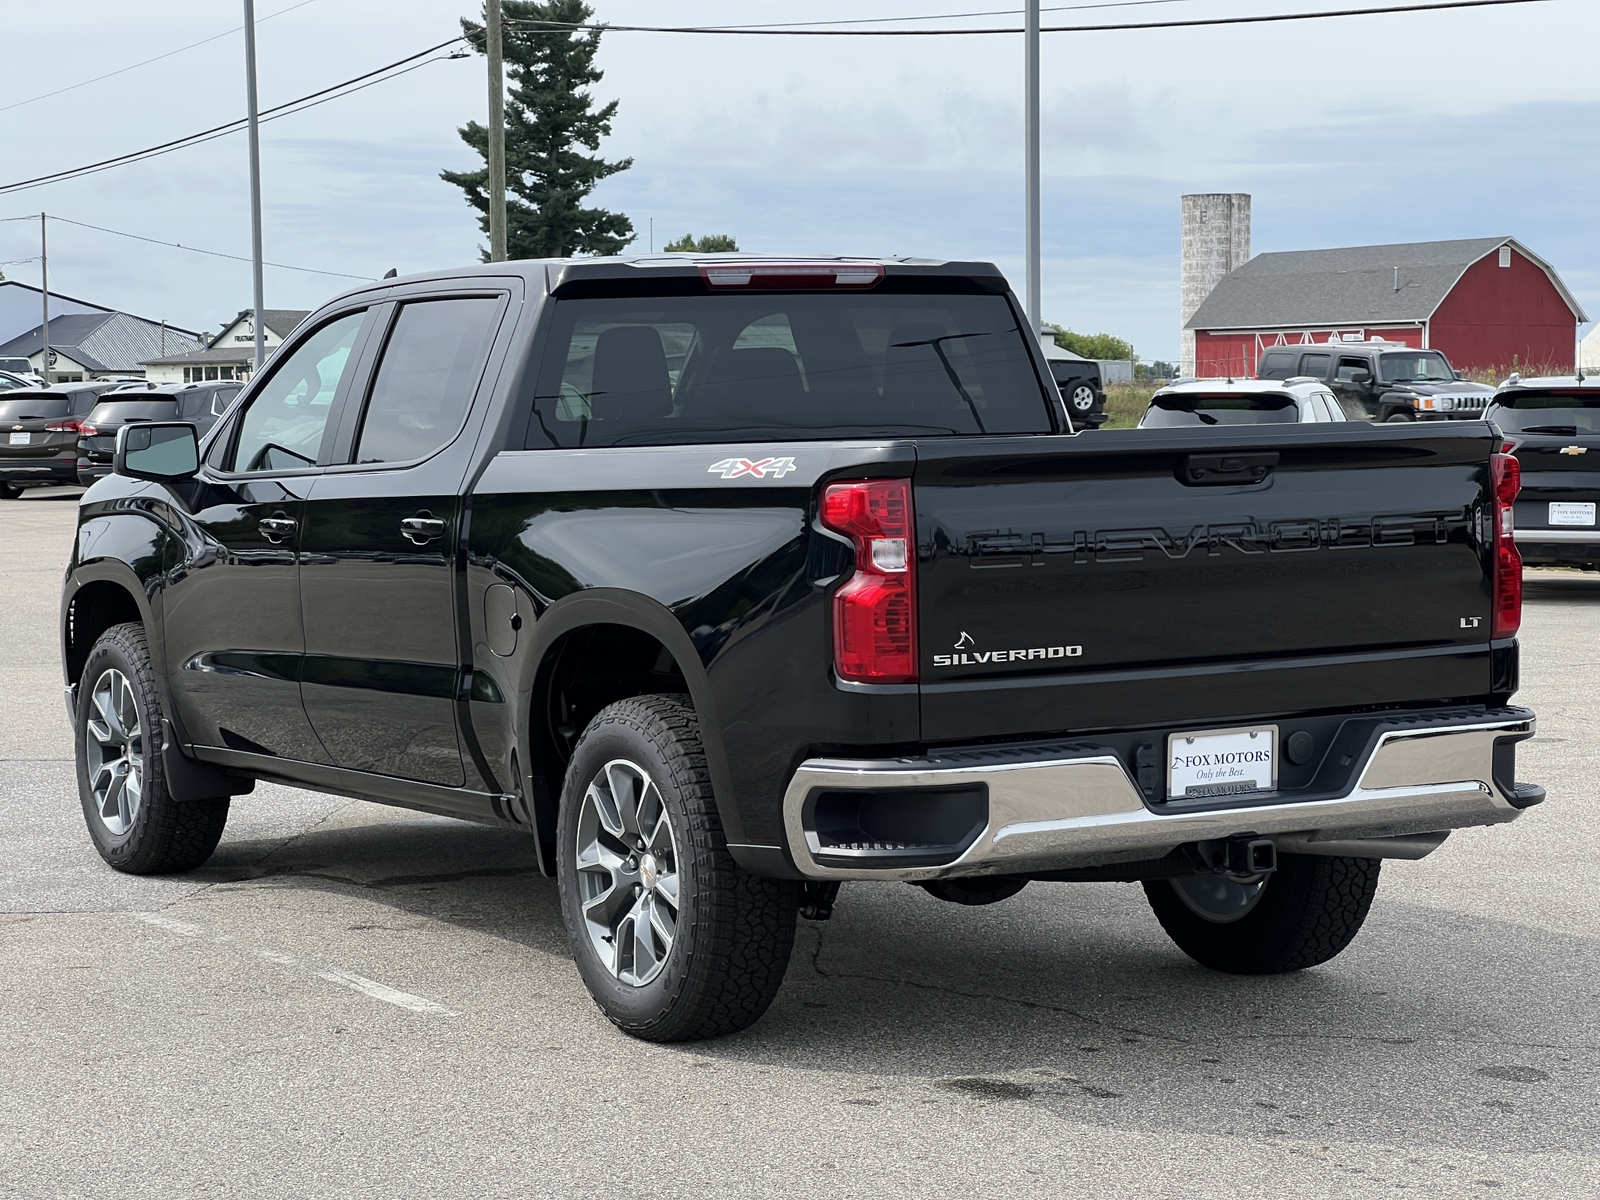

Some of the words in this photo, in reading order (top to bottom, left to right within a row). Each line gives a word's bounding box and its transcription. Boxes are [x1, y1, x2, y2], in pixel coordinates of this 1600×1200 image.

[968, 512, 1464, 569] CHEVROLET
[1460, 616, 1482, 629] LT
[933, 645, 1083, 667] SILVERADO
[1185, 754, 1211, 768] FOX
[1213, 750, 1270, 765] MOTORS
[1196, 768, 1214, 781] Only
[1215, 767, 1227, 778] the
[1228, 767, 1245, 777] Best.
